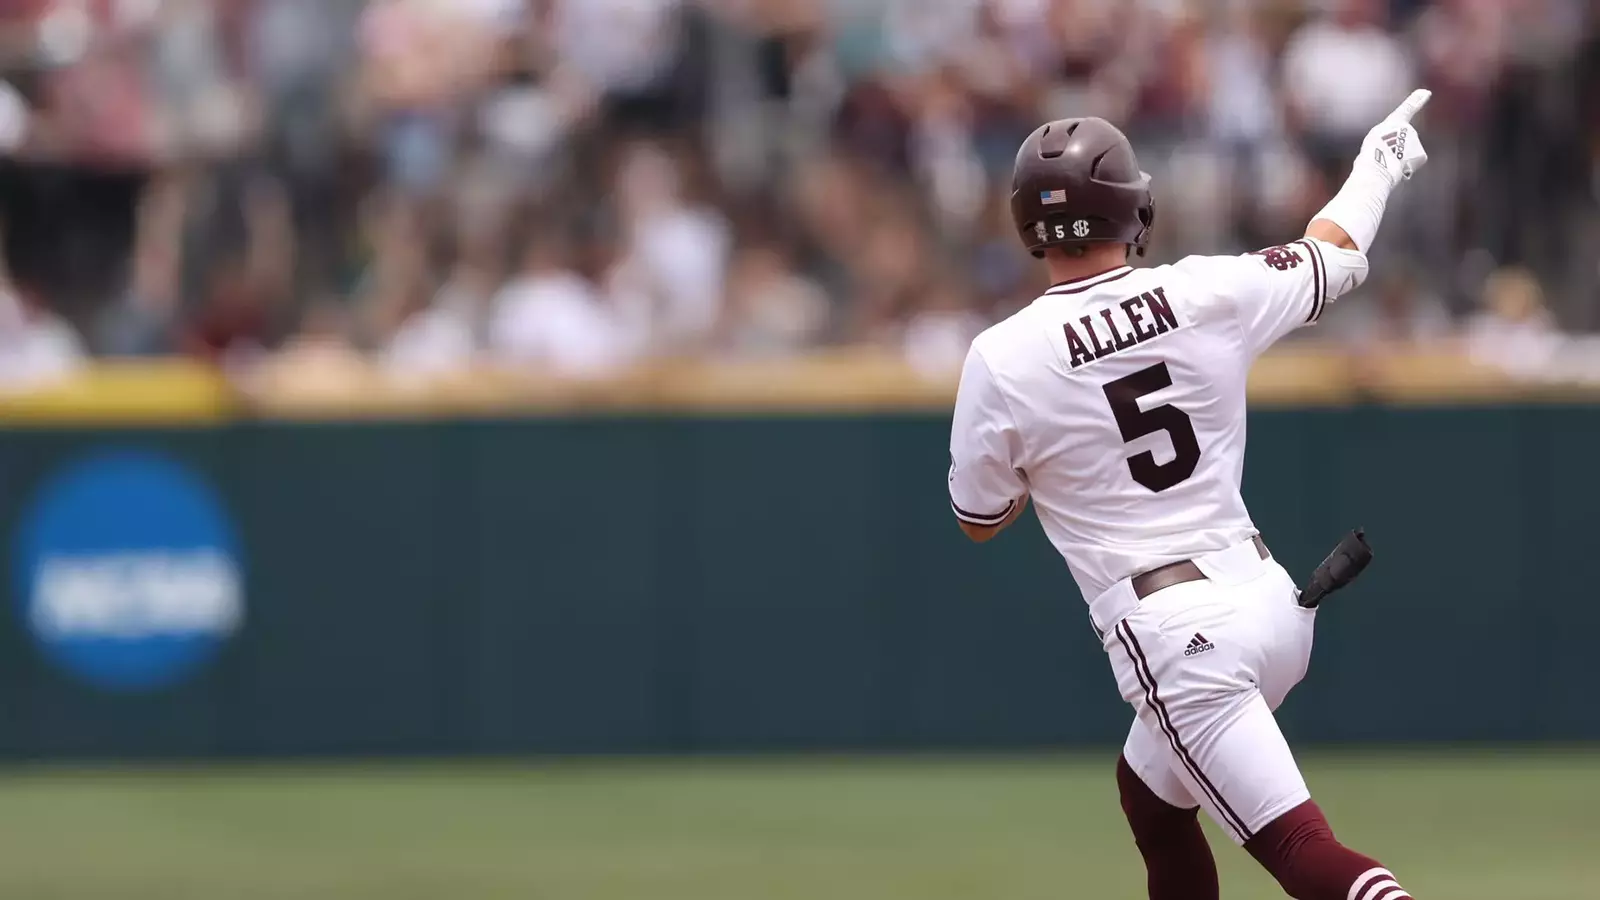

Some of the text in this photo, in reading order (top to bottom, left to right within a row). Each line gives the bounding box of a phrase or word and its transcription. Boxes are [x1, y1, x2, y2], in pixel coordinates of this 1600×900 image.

[1396, 127, 1408, 160] adidas
[1055, 225, 1065, 239] 5
[1072, 219, 1090, 237] SEC
[1063, 286, 1179, 368] ALLEN
[1102, 361, 1201, 493] 5
[1184, 643, 1215, 656] adidas
